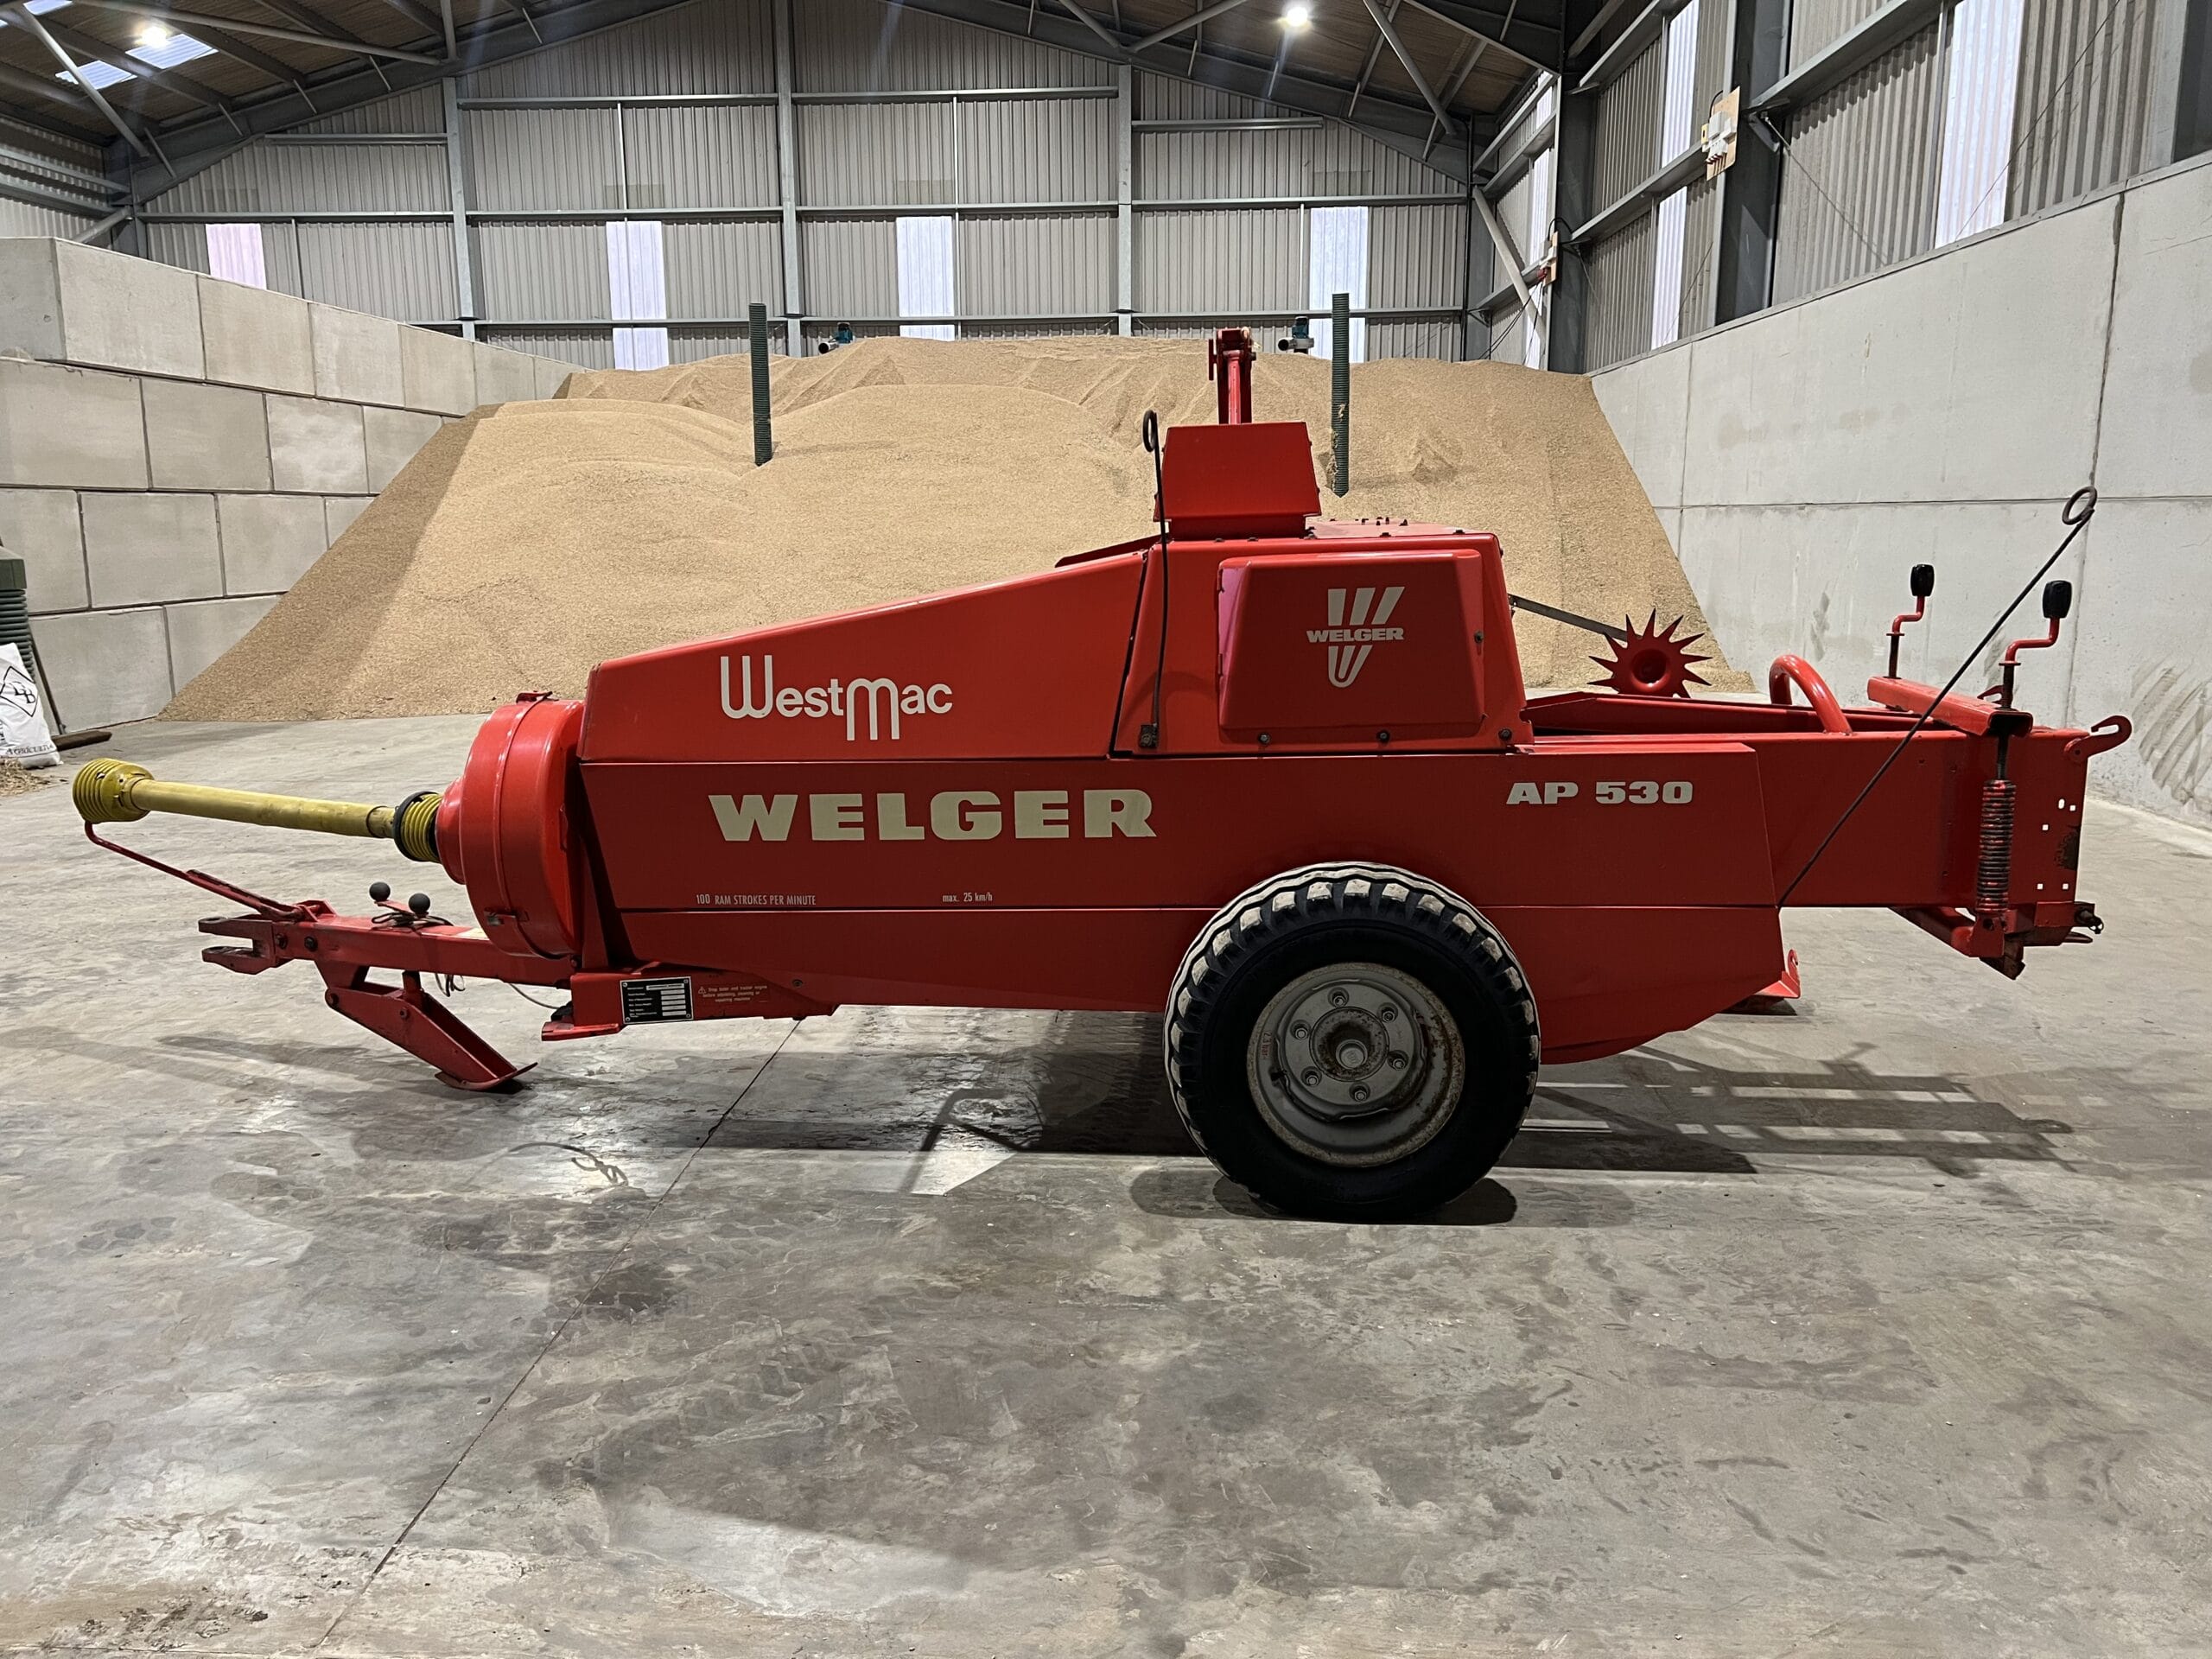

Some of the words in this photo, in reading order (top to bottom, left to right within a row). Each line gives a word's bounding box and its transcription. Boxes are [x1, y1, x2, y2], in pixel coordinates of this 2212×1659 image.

[1306, 627, 1405, 643] WELGER
[1506, 782, 1580, 805] AP
[1595, 781, 1694, 805] 530
[708, 789, 1157, 842] WELGER
[696, 893, 711, 905] 100
[715, 894, 731, 906] RAM
[734, 894, 767, 906] STROKES
[770, 894, 785, 906] PER
[786, 894, 817, 906] MINUTE
[963, 892, 973, 902] 25
[974, 892, 993, 902] km/h
